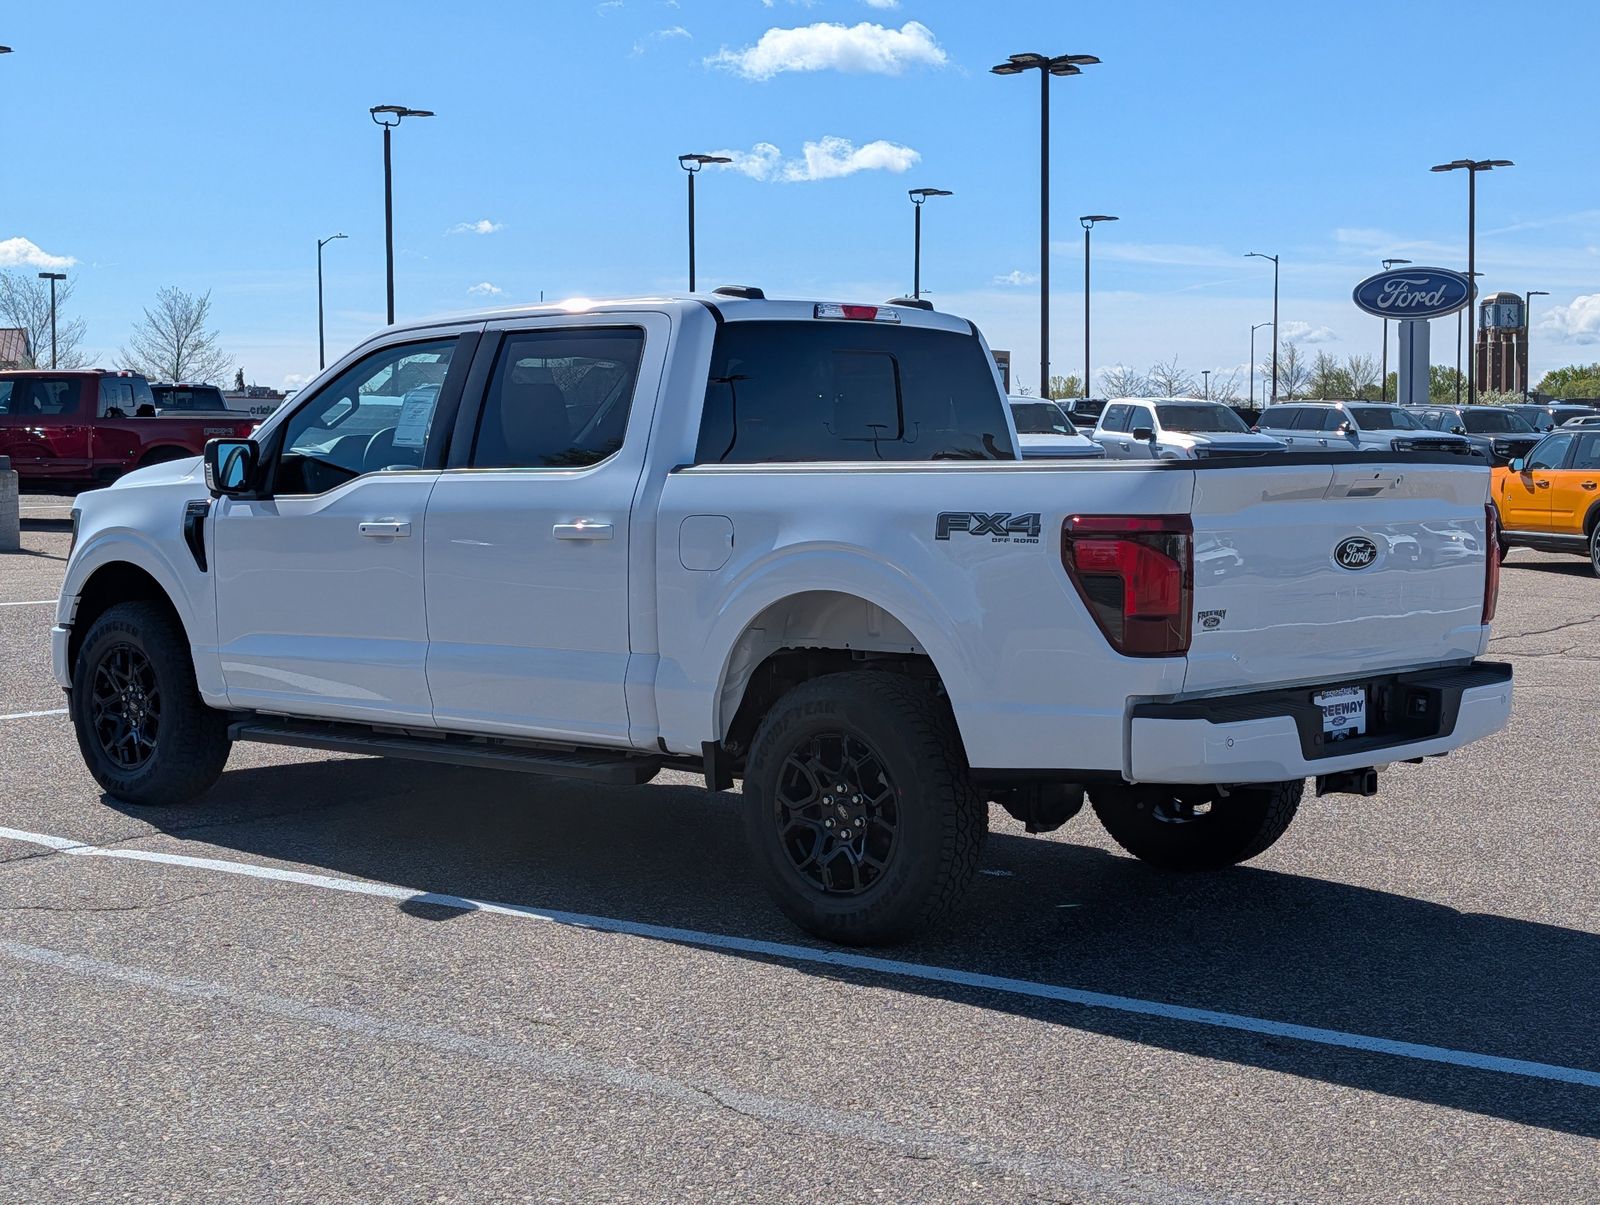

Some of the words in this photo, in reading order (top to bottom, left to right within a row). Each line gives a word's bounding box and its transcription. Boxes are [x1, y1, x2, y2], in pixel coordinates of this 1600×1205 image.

[1376, 278, 1447, 308] Ford
[935, 511, 1041, 541] FX4
[1342, 542, 1372, 565] Ford
[1197, 609, 1227, 624] FREEWAY
[1321, 700, 1363, 717] REEWAY
